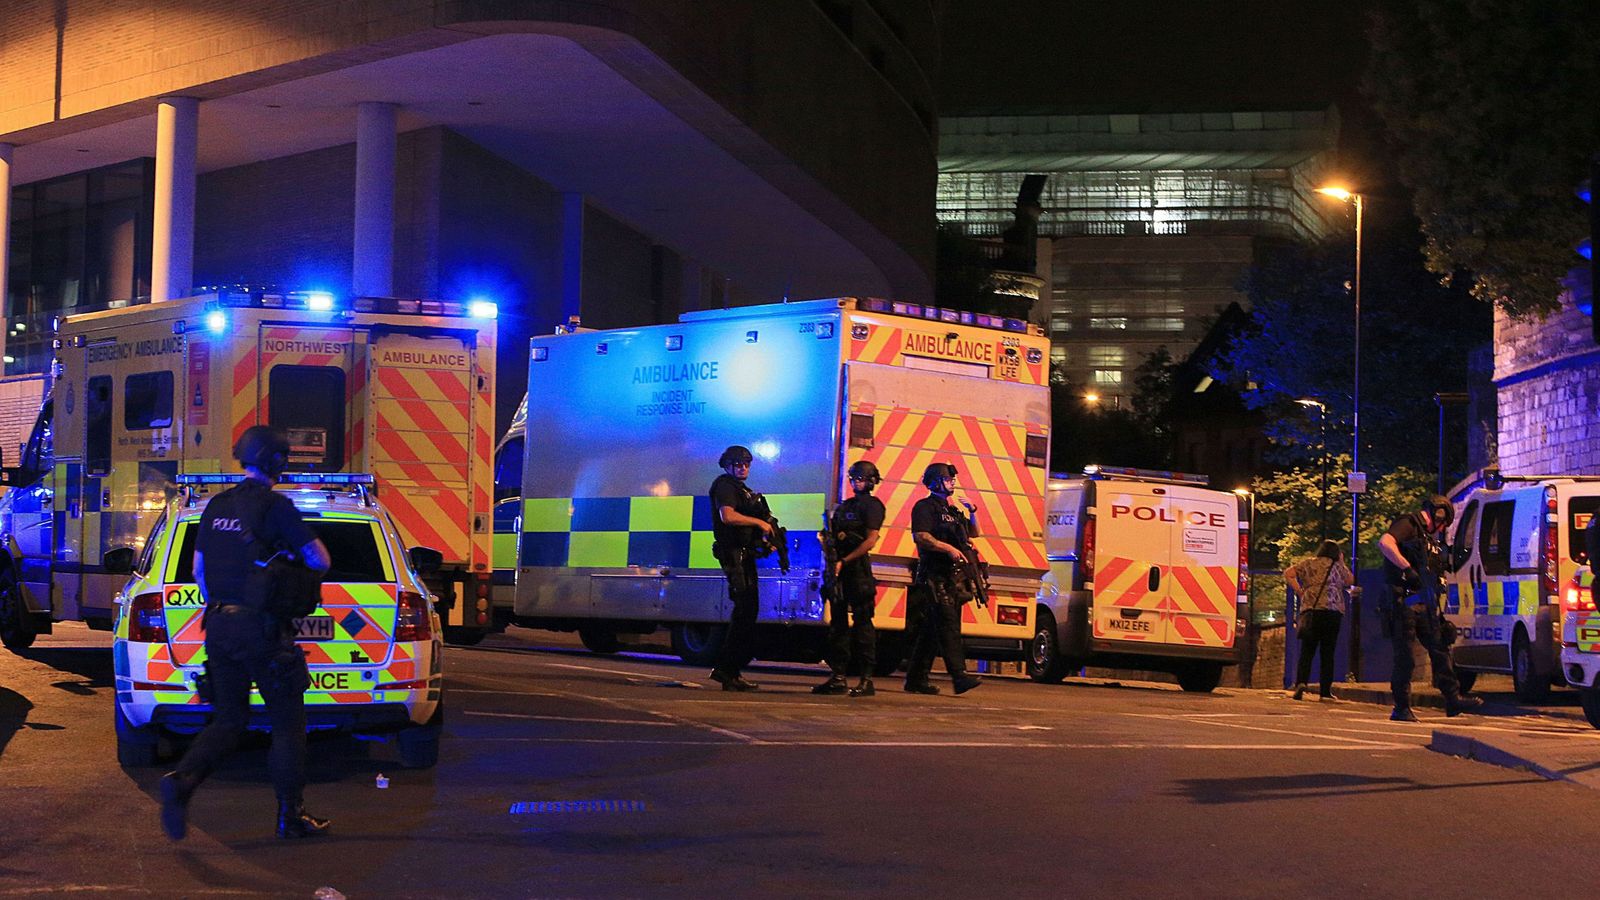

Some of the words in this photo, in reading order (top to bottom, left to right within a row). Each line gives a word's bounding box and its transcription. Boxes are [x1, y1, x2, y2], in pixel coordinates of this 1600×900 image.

[89, 343, 134, 363] EMERGENCY
[135, 336, 182, 357] AMBULANCE
[265, 340, 349, 354] NORTHWEST
[905, 333, 992, 362] AMBULANCE
[383, 351, 465, 366] AMBULANCE
[632, 361, 719, 384] AMBULANCE
[652, 389, 694, 403] INCIDENT
[636, 402, 682, 416] RESPONSE
[685, 402, 707, 415] UNIT
[1046, 514, 1075, 526] POLICE
[1111, 504, 1226, 528] POLICE
[212, 518, 242, 531] POLIC
[1132, 621, 1151, 632] EFE
[1455, 627, 1503, 640] POLICE
